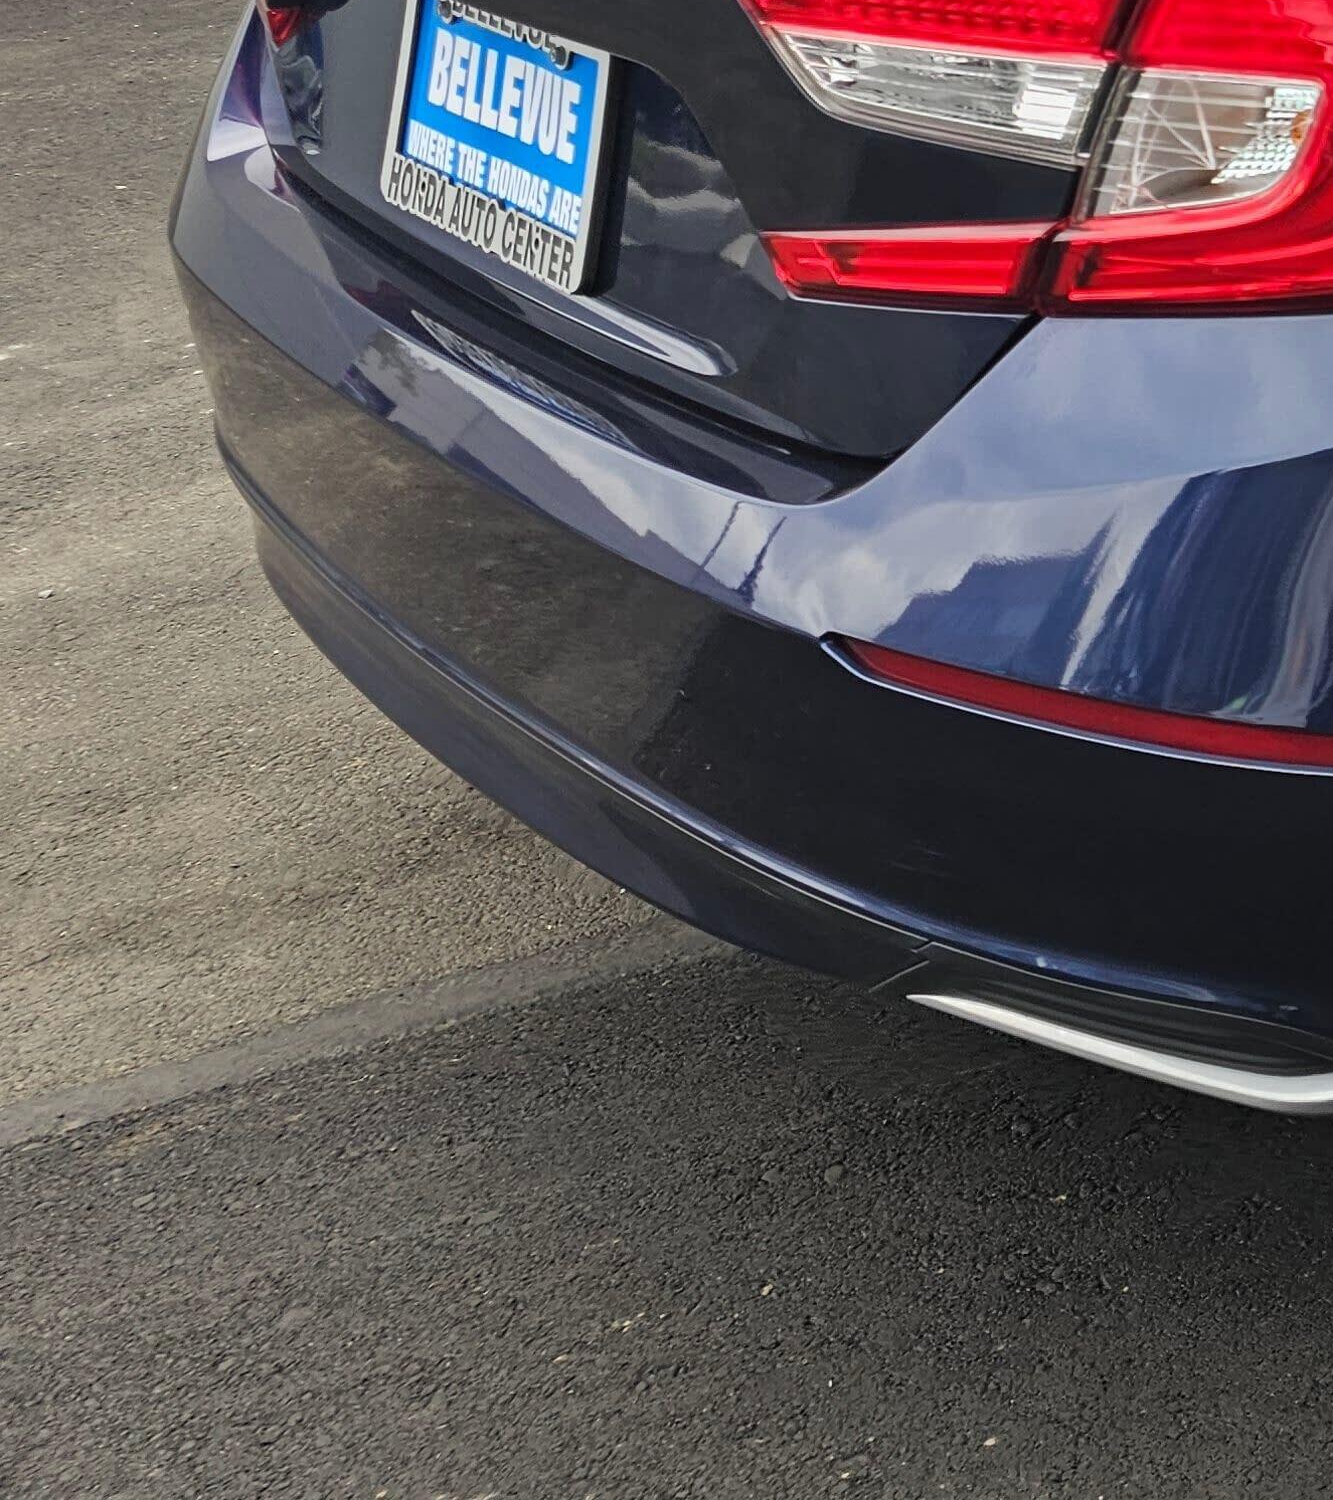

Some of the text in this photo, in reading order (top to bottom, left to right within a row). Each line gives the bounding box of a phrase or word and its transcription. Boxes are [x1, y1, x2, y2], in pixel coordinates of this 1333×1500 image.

[427, 27, 582, 165] BELLEVUE
[387, 156, 575, 290] HONDA AUTO CENTER
[406, 119, 582, 235] WHERE THE HONDAS ARE
